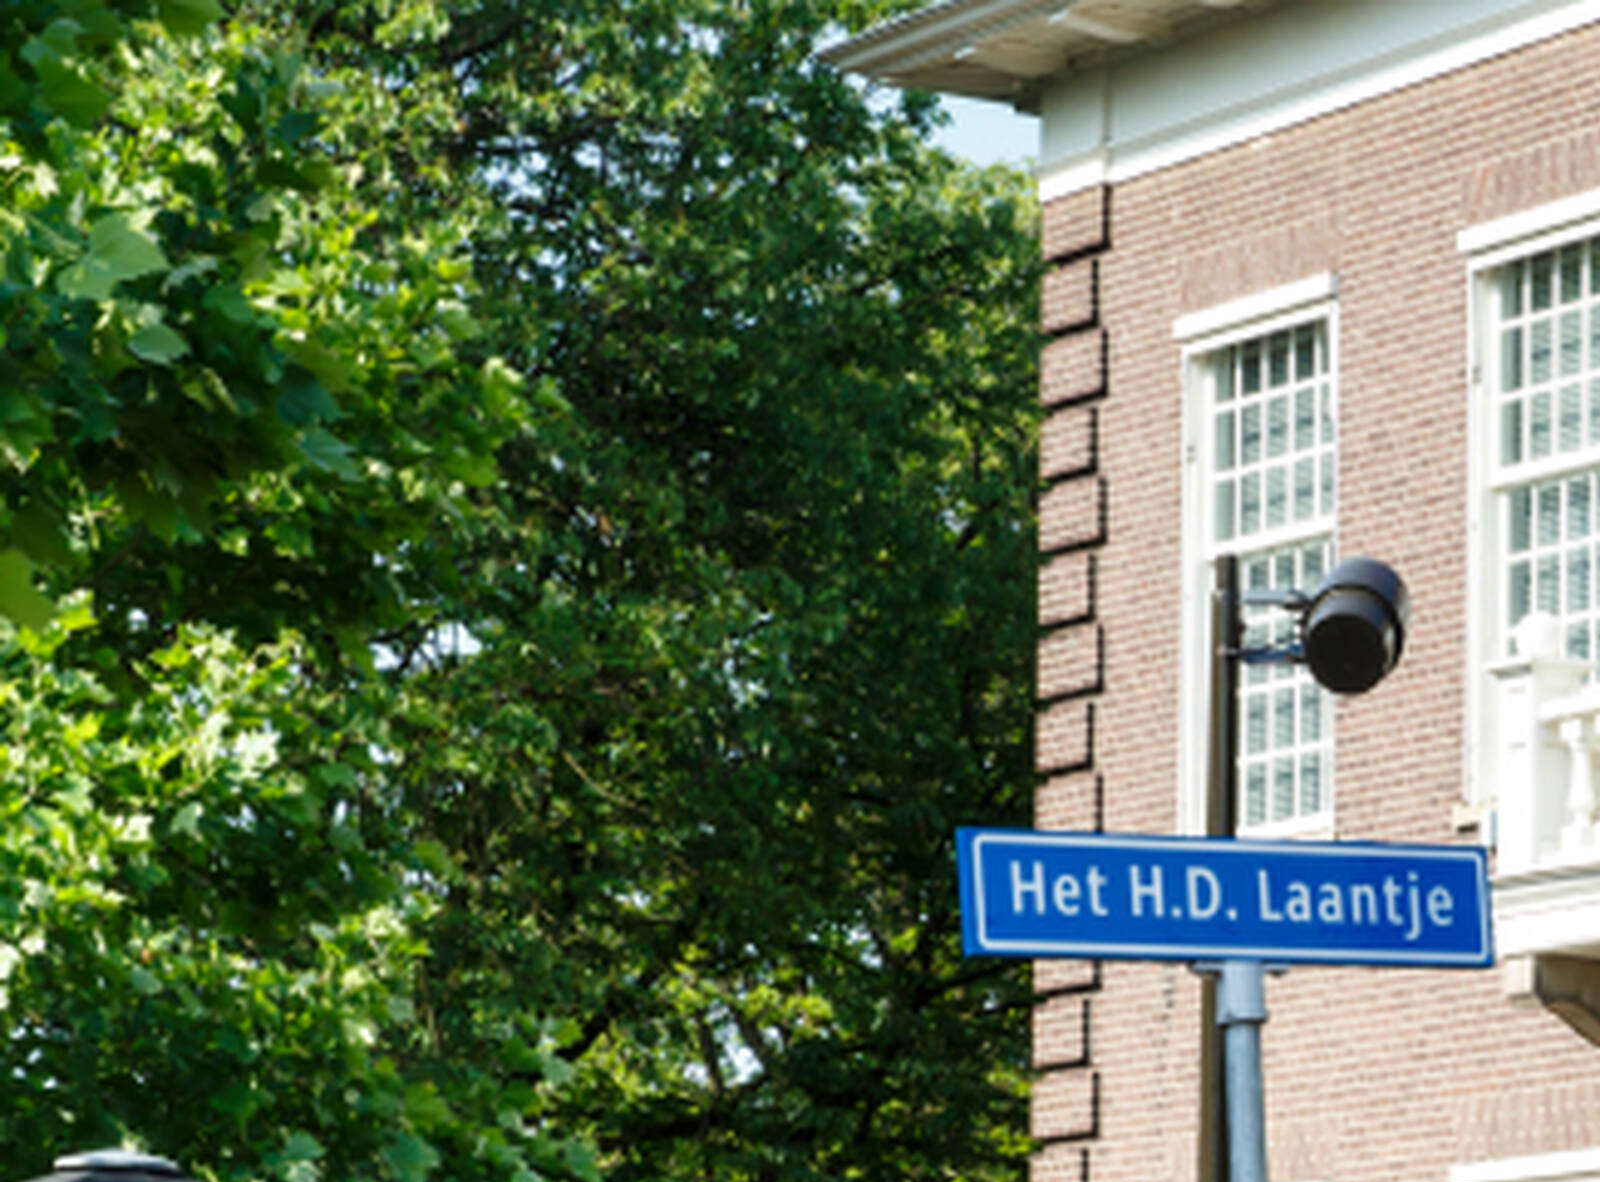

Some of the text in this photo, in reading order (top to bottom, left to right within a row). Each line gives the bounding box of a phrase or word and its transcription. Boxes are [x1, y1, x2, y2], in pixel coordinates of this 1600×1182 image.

[1010, 860, 1454, 941] Het H.D. Laantje
